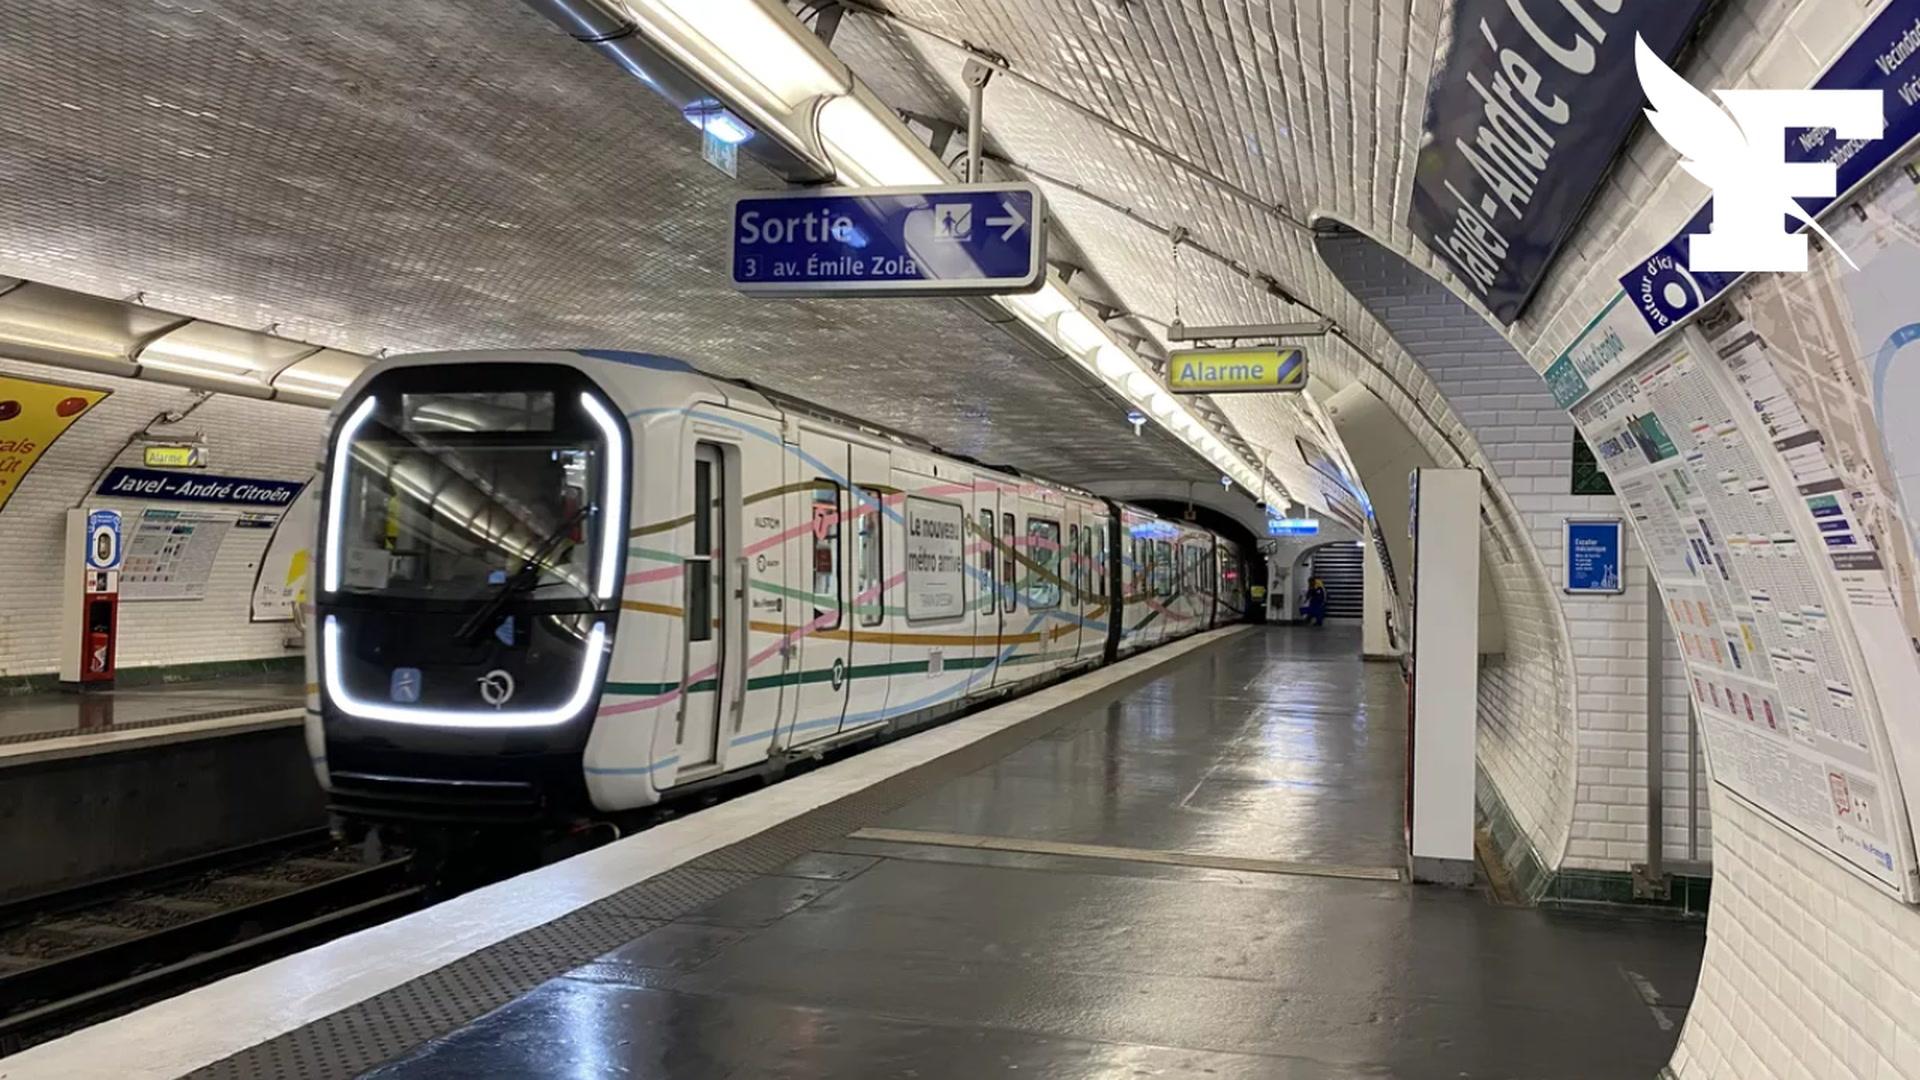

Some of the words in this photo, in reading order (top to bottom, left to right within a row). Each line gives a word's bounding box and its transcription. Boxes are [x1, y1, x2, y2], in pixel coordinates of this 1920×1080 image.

[740, 209, 854, 245] Sortie
[744, 259, 757, 277] 3
[773, 261, 800, 277] av.
[807, 254, 864, 276] Émile
[871, 256, 917, 276] Zola
[1641, 275, 1669, 327] autour
[1180, 361, 1265, 381] Alarme
[232, 485, 291, 502] Citroën
[909, 511, 921, 536] Le
[922, 519, 960, 540] nouveau
[908, 546, 936, 573] métro
[833, 664, 843, 685] 12
